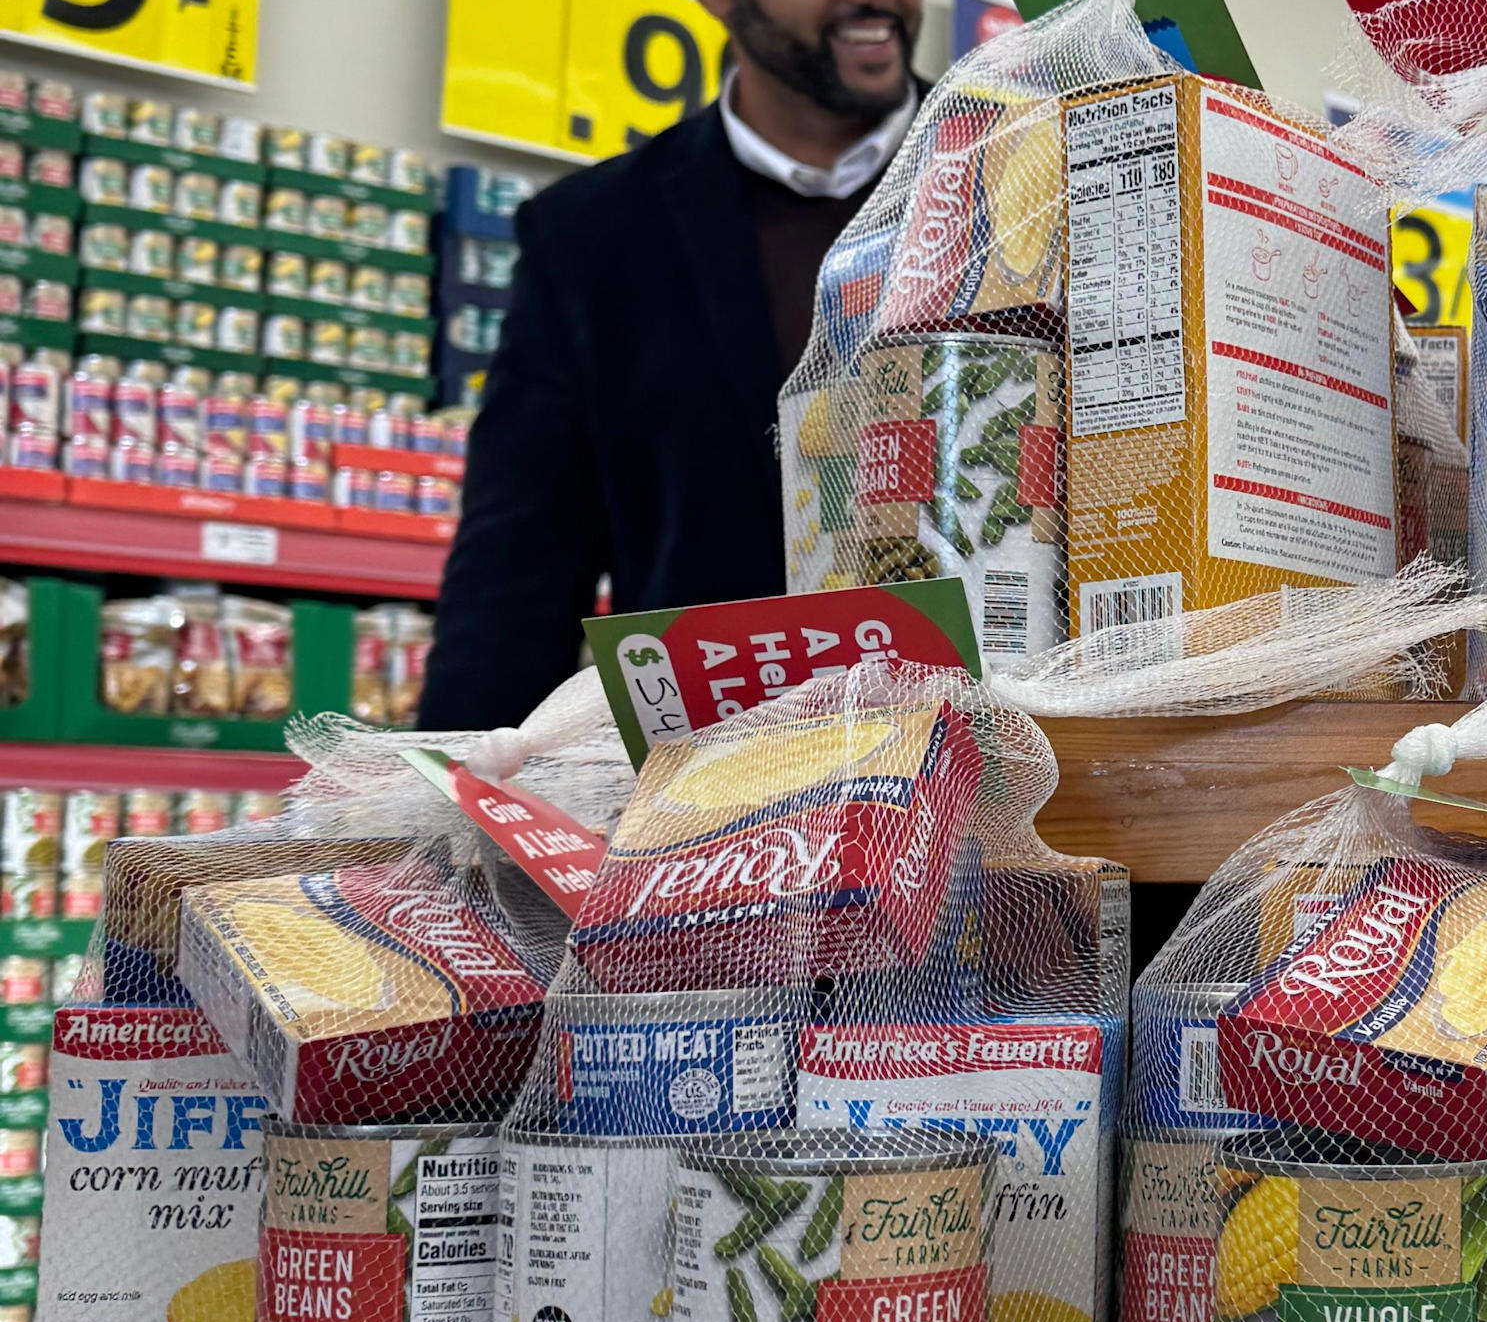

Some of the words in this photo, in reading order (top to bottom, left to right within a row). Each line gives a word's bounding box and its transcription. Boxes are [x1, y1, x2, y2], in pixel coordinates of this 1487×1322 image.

[1068, 102, 1128, 127] Nutrition
[1133, 92, 1173, 112] Facts
[897, 152, 968, 292] Royal
[478, 797, 534, 824] Give
[513, 834, 541, 859] A
[528, 828, 596, 856] Little.
[628, 828, 848, 916] Royal
[1288, 884, 1432, 999] Royal
[64, 1016, 211, 1046] America's
[1355, 993, 1408, 1041] Vanilla
[328, 1027, 452, 1080] Royal
[571, 1029, 650, 1064] POTTED
[655, 1024, 725, 1059] MEAT
[808, 1032, 961, 1063] America's
[965, 1034, 1091, 1064] Favorite
[1248, 1034, 1362, 1089] Royal
[1403, 1078, 1445, 1100] Vanilla
[70, 1163, 163, 1193] corn
[274, 1155, 380, 1203] Fairhill
[149, 1199, 233, 1230] mix
[862, 1186, 974, 1244] Fairhill
[1315, 1200, 1446, 1258] Fairhill
[277, 1245, 354, 1282] GREEN
[418, 1241, 486, 1260] Calories
[275, 1287, 353, 1320] BEANS
